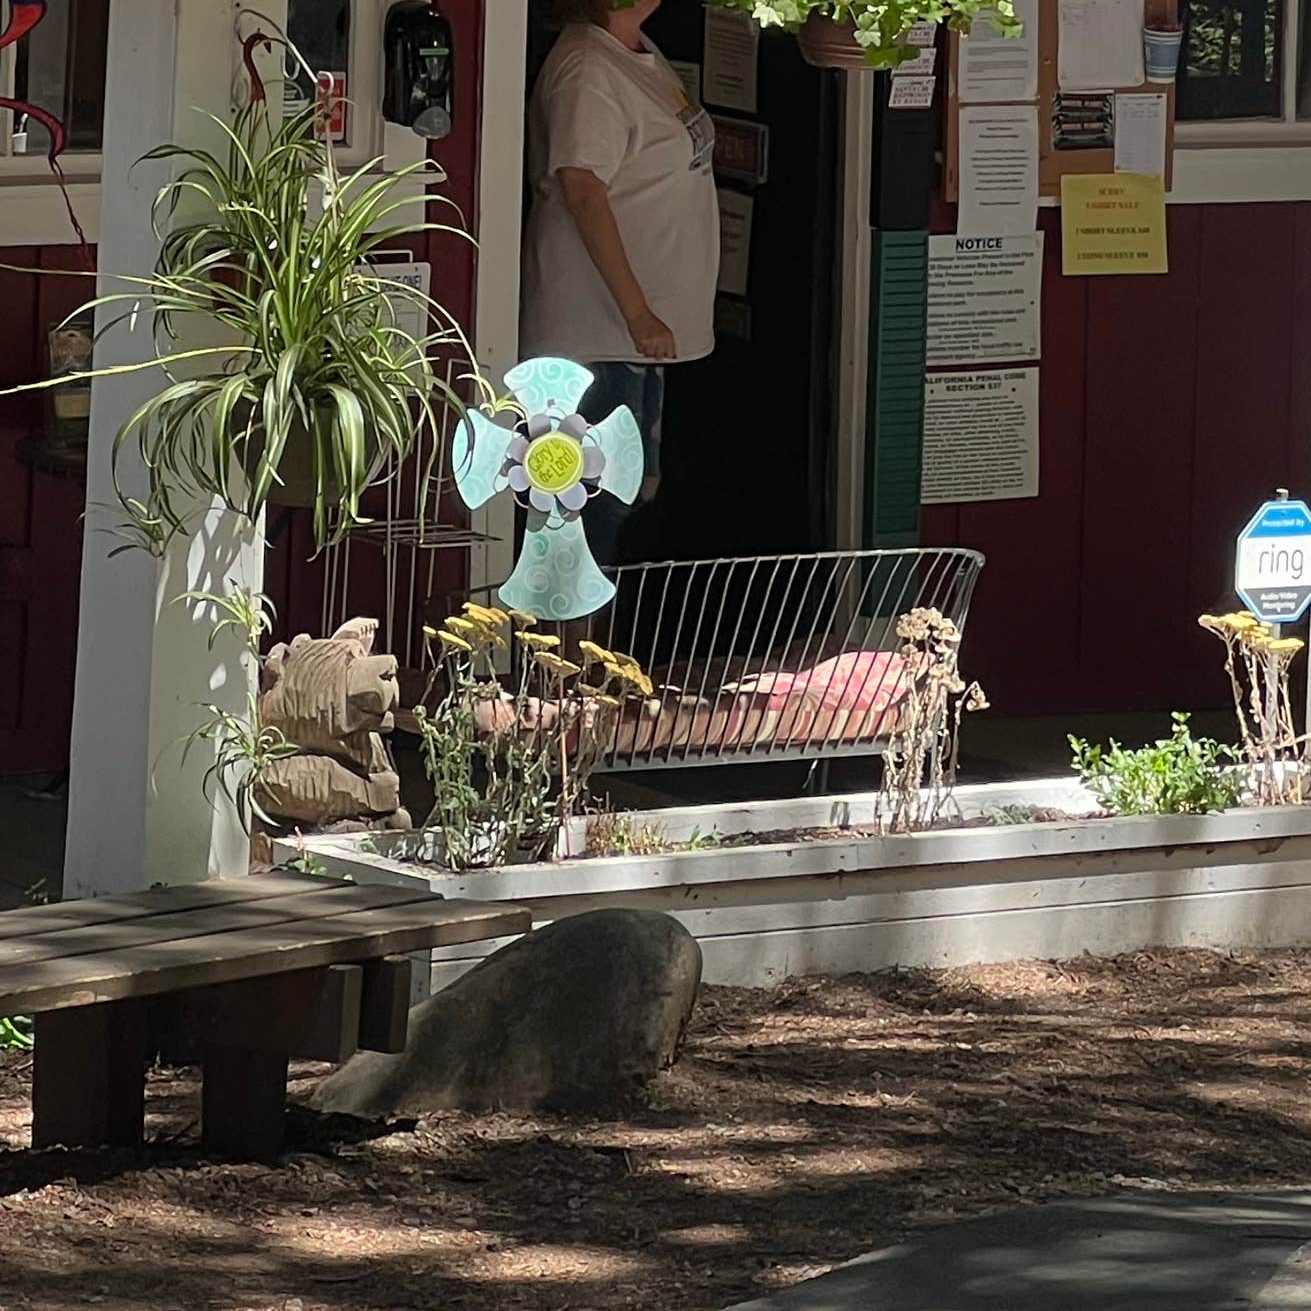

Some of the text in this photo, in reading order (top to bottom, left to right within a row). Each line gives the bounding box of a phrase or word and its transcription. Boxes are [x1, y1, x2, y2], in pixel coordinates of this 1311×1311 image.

[955, 237, 1004, 250] NOTICE
[924, 376, 974, 385] ALIFORNIA
[1004, 372, 1027, 381] CODE
[945, 383, 986, 392] SECTION
[1258, 543, 1304, 580] ring
